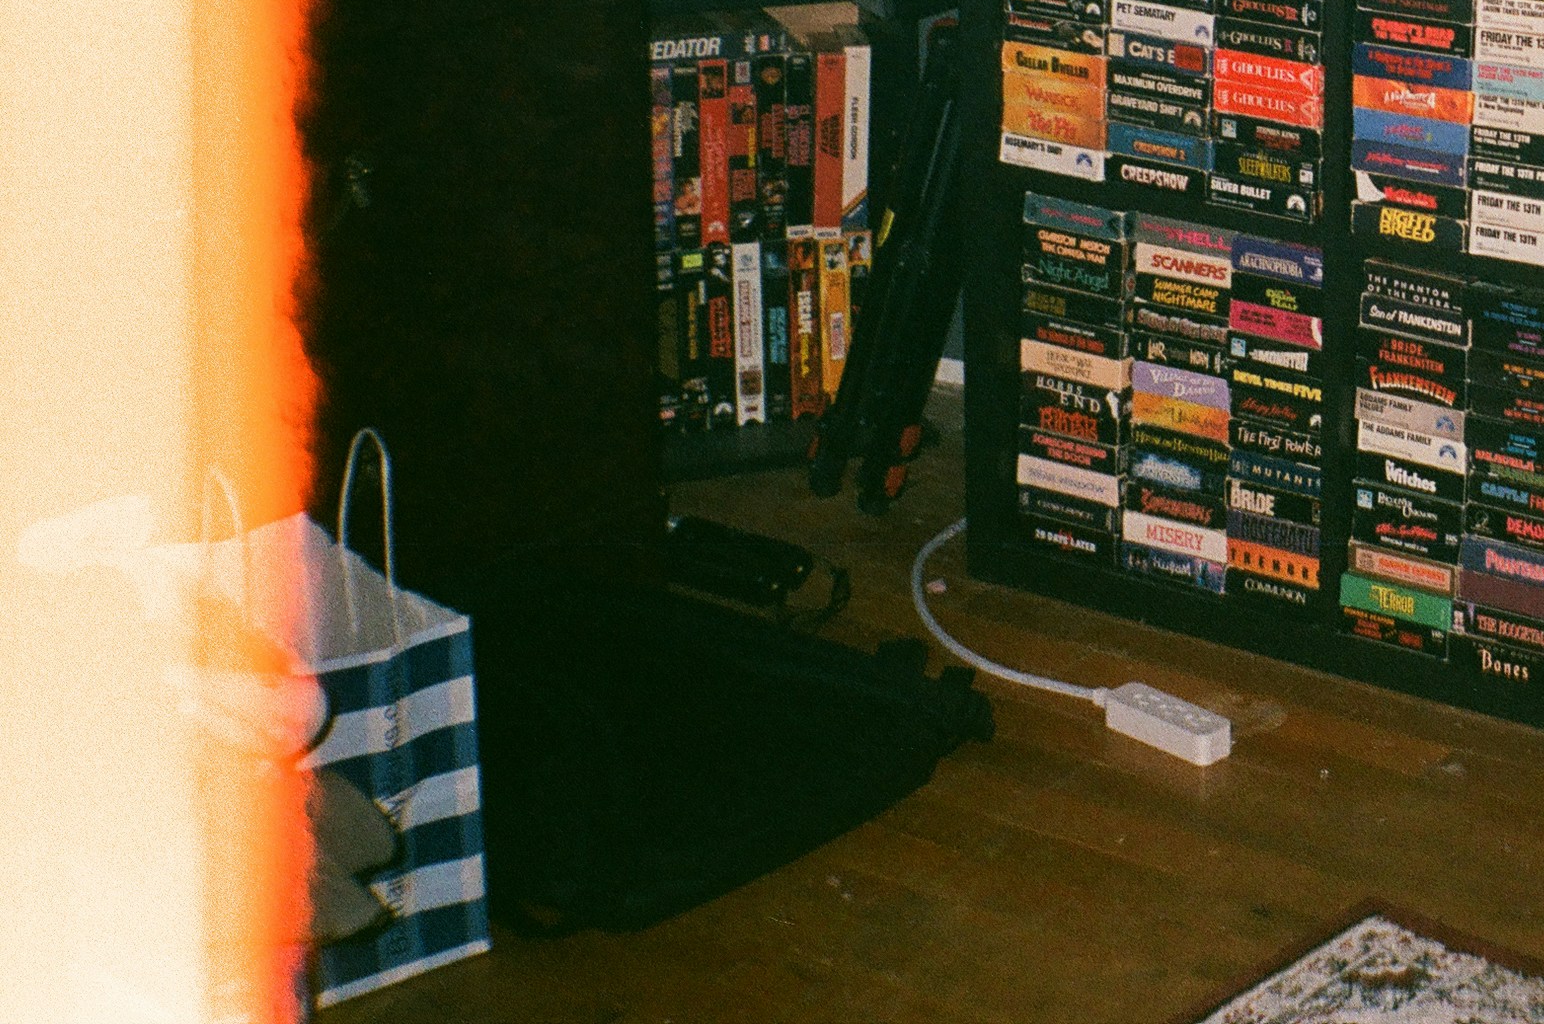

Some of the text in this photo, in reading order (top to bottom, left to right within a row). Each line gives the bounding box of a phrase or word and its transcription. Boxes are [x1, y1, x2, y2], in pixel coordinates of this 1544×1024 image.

[1116, 1, 1176, 22] PET SEMATARY
[650, 36, 721, 60] EDATOR
[1479, 28, 1513, 45] FRIDAY
[1515, 33, 1532, 47] THE
[1231, 59, 1296, 84] GHOULIES
[1113, 73, 1203, 101] MAXIMUM OVERDRIVE
[1231, 90, 1296, 115] GHOULIES
[1120, 163, 1189, 192] CREEPSHOW
[1474, 161, 1498, 175] FRIDAY
[1500, 166, 1515, 177] THE
[1211, 178, 1272, 201] SILVER BULLET
[1475, 225, 1538, 247] FRIDAY THE 13TH
[1150, 254, 1227, 282] SCANNERS
[1153, 278, 1220, 300] SUMMER CAMP
[1366, 283, 1453, 311] OF THE OPERA
[1367, 273, 1450, 299] THE PHANTOM
[1152, 291, 1218, 313] NIGHTMARE
[1369, 304, 1463, 337] Son of FRANKENSTEIN
[1390, 338, 1424, 355] BRIDE
[1378, 349, 1445, 375] FRANKENSTEIN
[1232, 369, 1322, 401] DEVIL TIMES FIVE
[1368, 365, 1458, 406] FRANKENSTEIN
[1059, 392, 1101, 415] END
[1388, 398, 1413, 413] FAMILY
[1362, 420, 1432, 447] THE ADDAMS FAMILY
[1145, 523, 1204, 551] MISERY
[1475, 614, 1498, 631] THE
[1481, 648, 1529, 681] Bones
